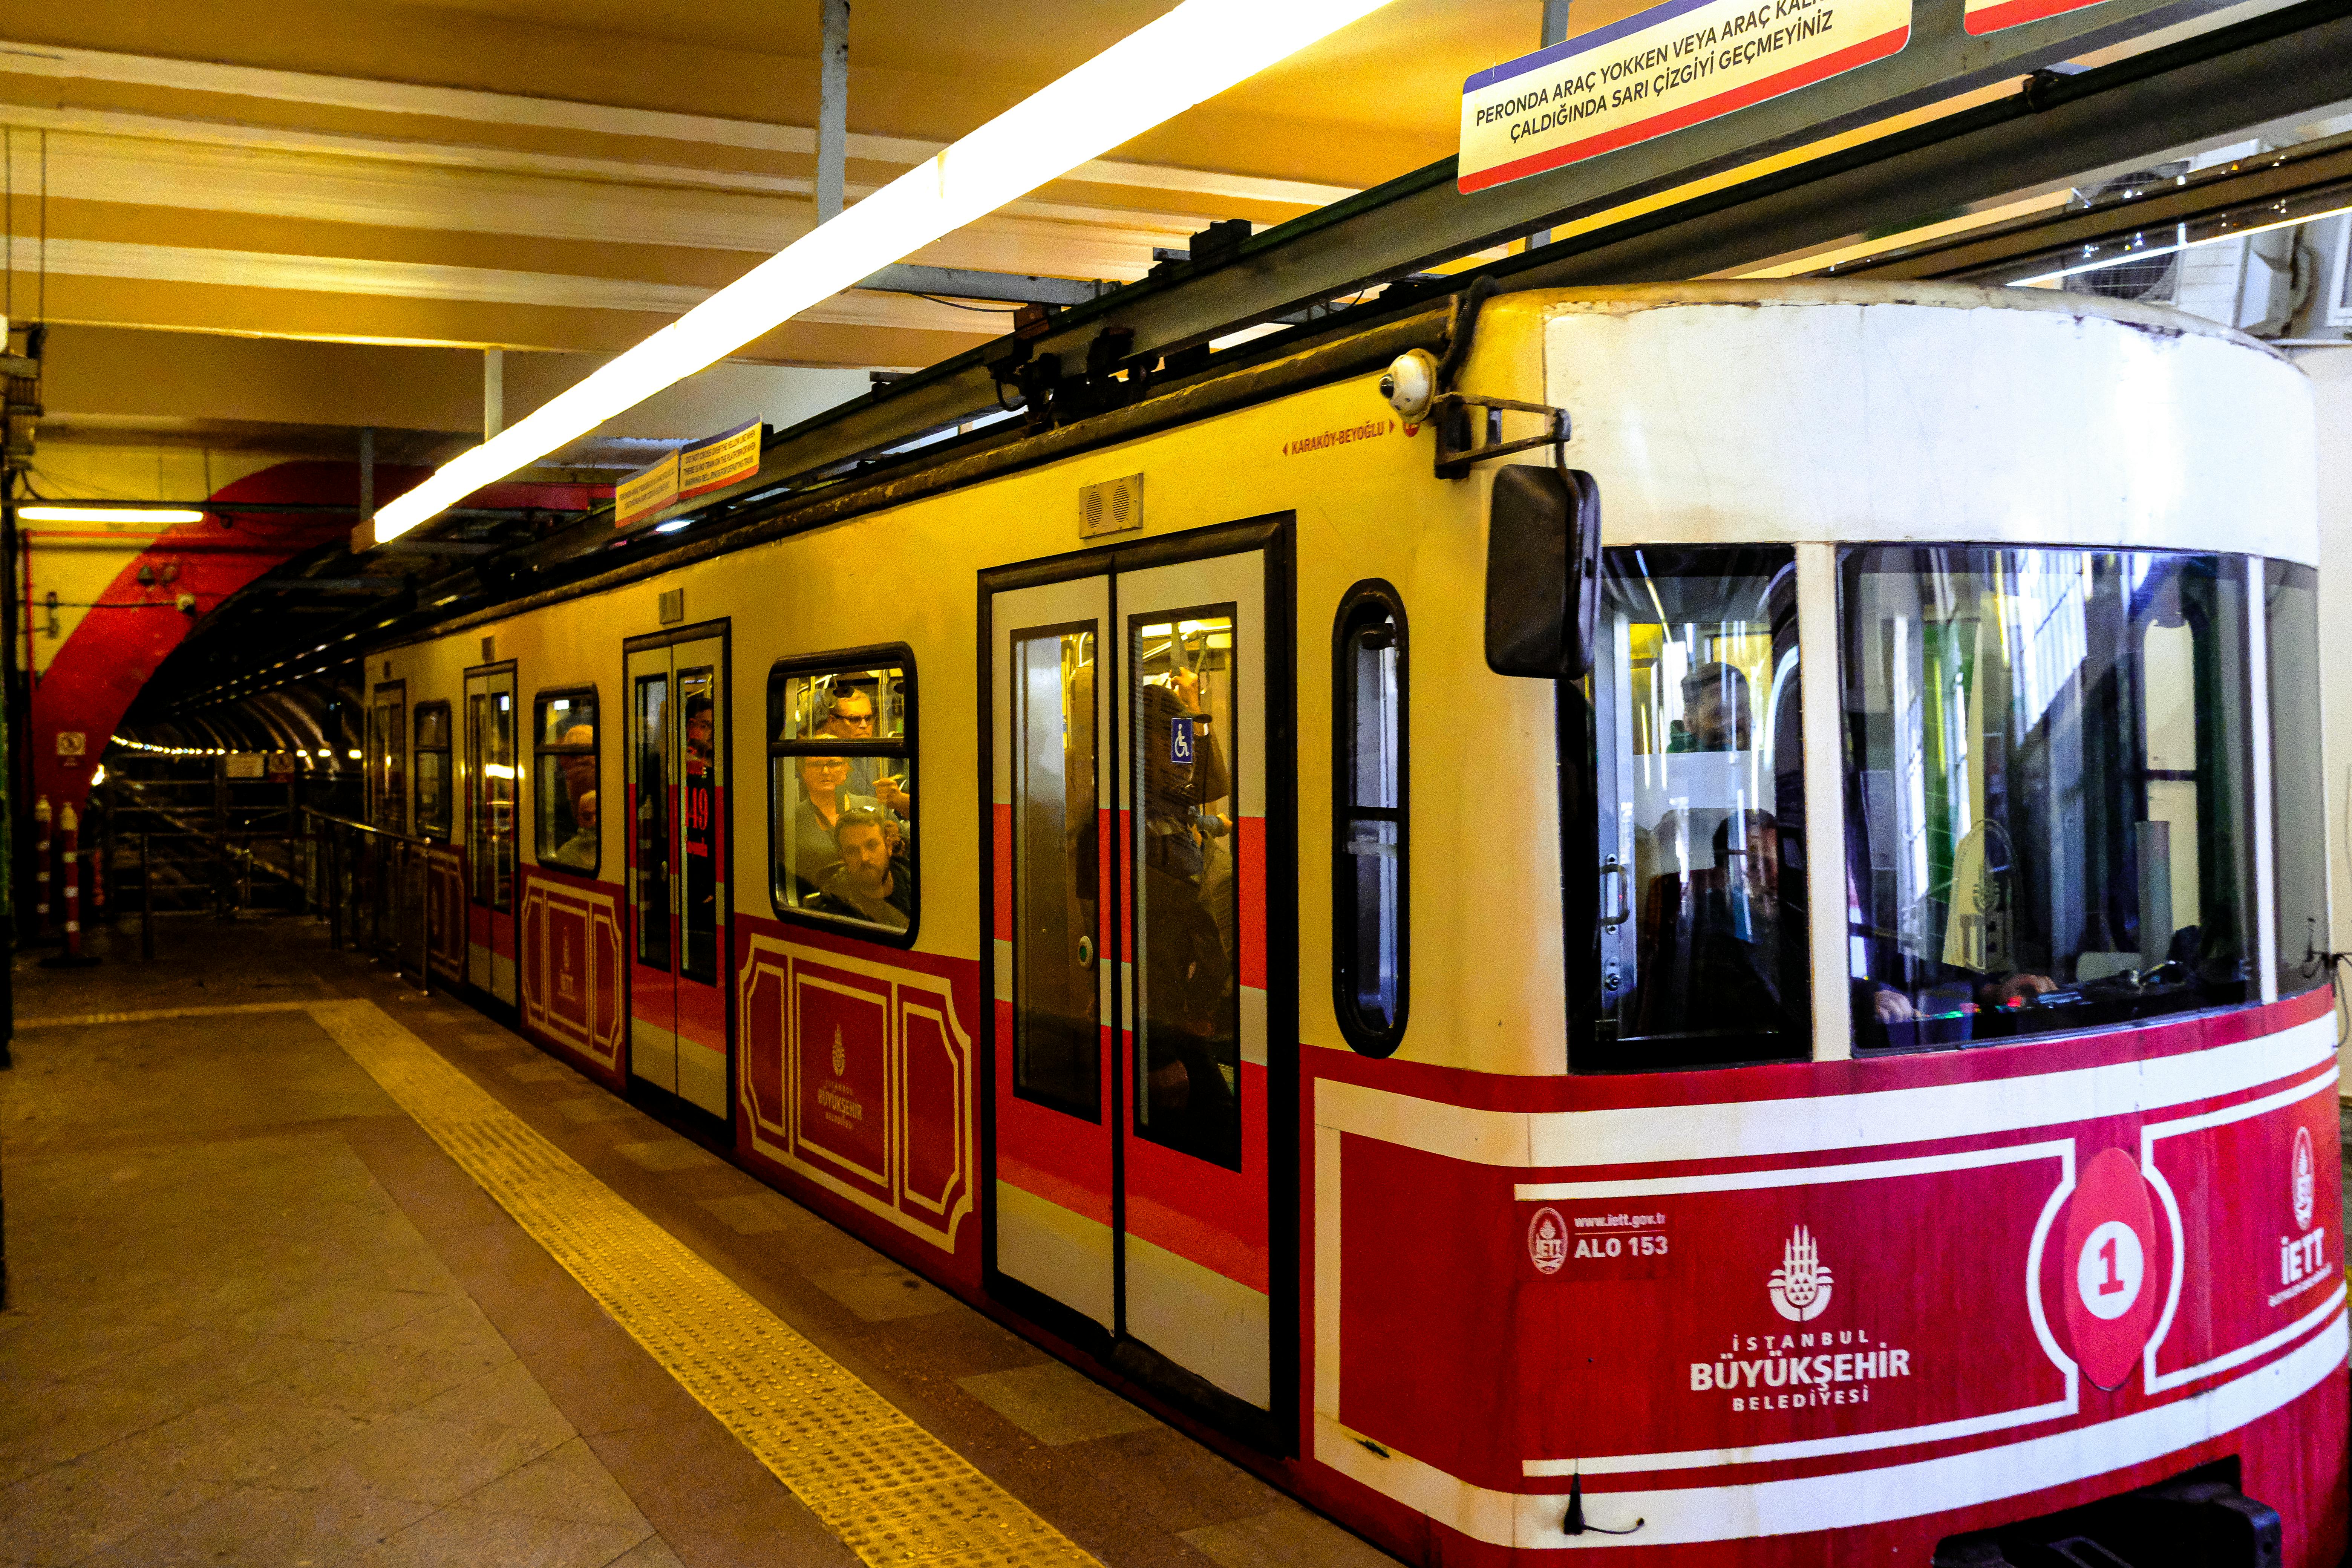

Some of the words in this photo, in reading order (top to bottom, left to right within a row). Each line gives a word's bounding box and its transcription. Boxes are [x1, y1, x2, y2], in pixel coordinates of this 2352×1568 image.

[1476, 89, 1548, 126] PERONDA
[1552, 72, 1597, 101] ARAÇ
[1601, 44, 1668, 84] YOKKEN
[1673, 27, 1717, 58] VEYA
[1721, 5, 1770, 41] ARAÇ
[1510, 95, 1607, 144] ÇALDIĞINDA
[1612, 80, 1648, 108] SARI
[1653, 51, 1714, 98] ÇİZGİYİ
[1719, 9, 1833, 70] GEÇMEYİNİZ
[1291, 420, 1384, 455] KARAKÖY-BEYOĞLU
[1574, 1237, 1621, 1258] ALO
[1628, 1235, 1668, 1256] 153
[2098, 1237, 2124, 1296] 1
[1732, 1329, 1870, 1352] İSTANBUL
[1690, 1342, 1910, 1392] BÜYÜKŞEHİR
[1732, 1384, 1870, 1412] BELEDİYESİ
